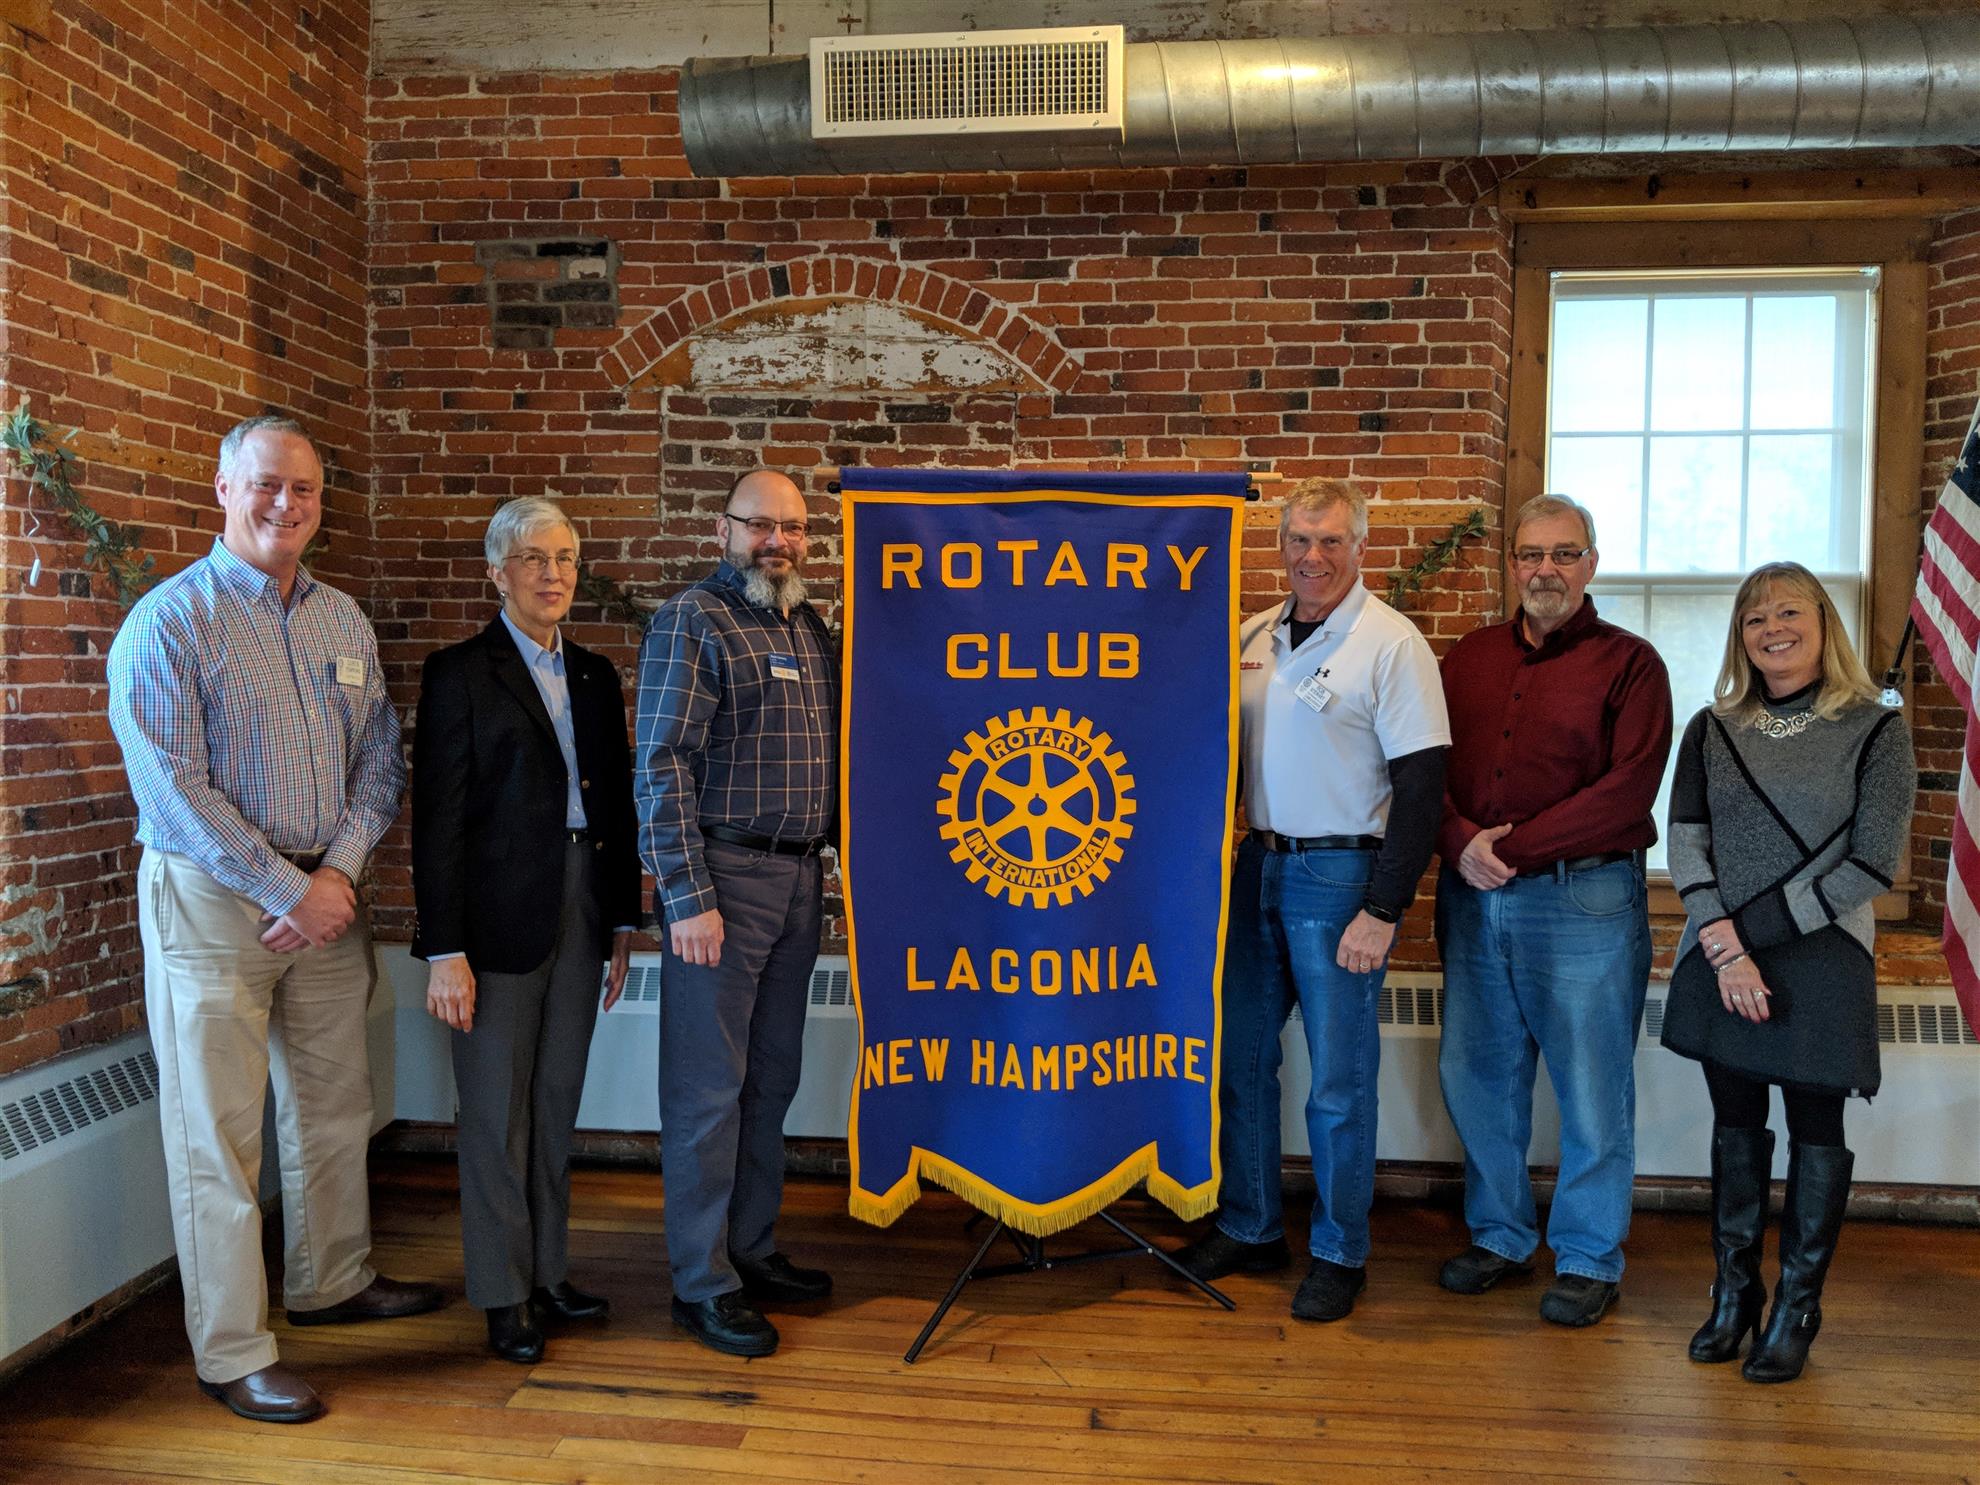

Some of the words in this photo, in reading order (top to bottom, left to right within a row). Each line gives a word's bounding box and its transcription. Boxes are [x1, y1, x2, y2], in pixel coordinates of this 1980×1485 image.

[881, 540, 1209, 591] ROTARY
[946, 632, 1140, 679] CLUB
[990, 727, 1089, 760] ROTARY
[965, 831, 1108, 888] INTERNATIONAL
[906, 943, 1158, 996] LACONIA
[863, 1038, 950, 1090] NEW
[971, 1033, 1206, 1091] HAMPSHIRE
